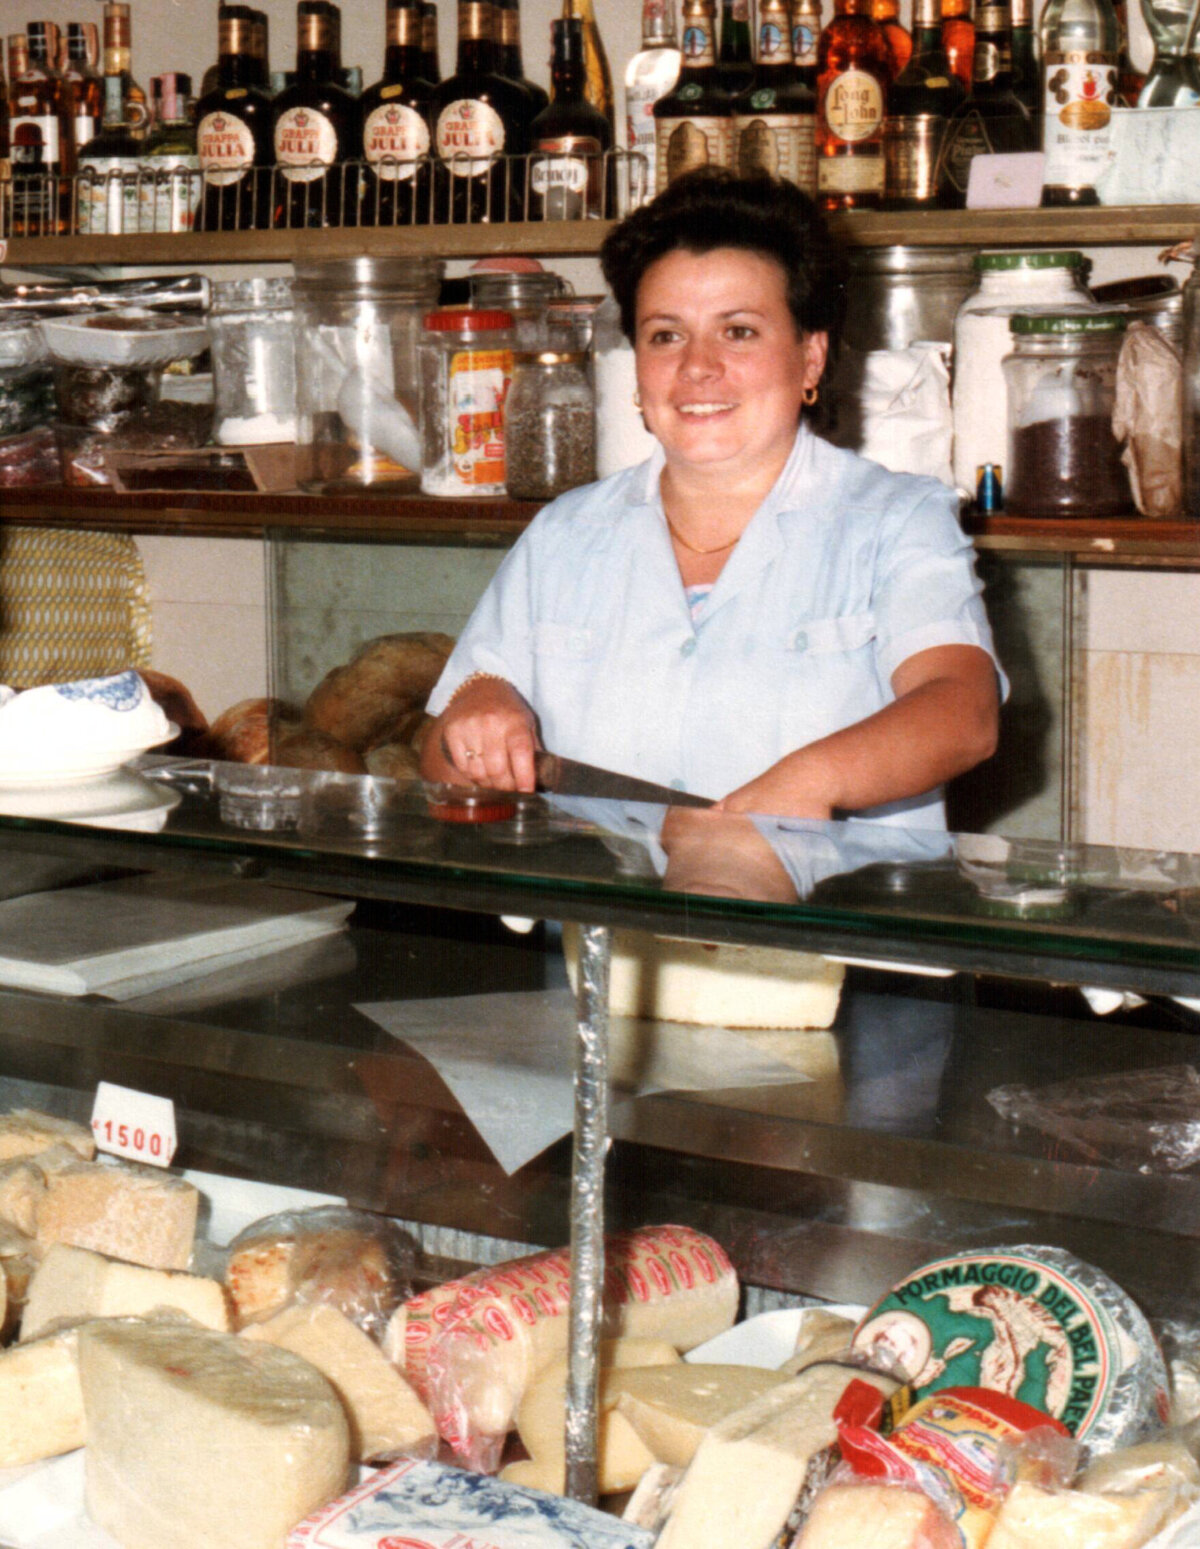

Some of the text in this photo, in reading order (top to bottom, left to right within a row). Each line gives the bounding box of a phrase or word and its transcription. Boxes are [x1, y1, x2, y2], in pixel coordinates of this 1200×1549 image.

[831, 84, 870, 110] Long
[282, 129, 319, 139] GRAPP
[200, 143, 246, 157] JULIA
[104, 1119, 162, 1157] 1500
[894, 1263, 1040, 1305] FORMAGGIO
[1040, 1281, 1076, 1327] DEL
[1069, 1320, 1098, 1371] BEL
